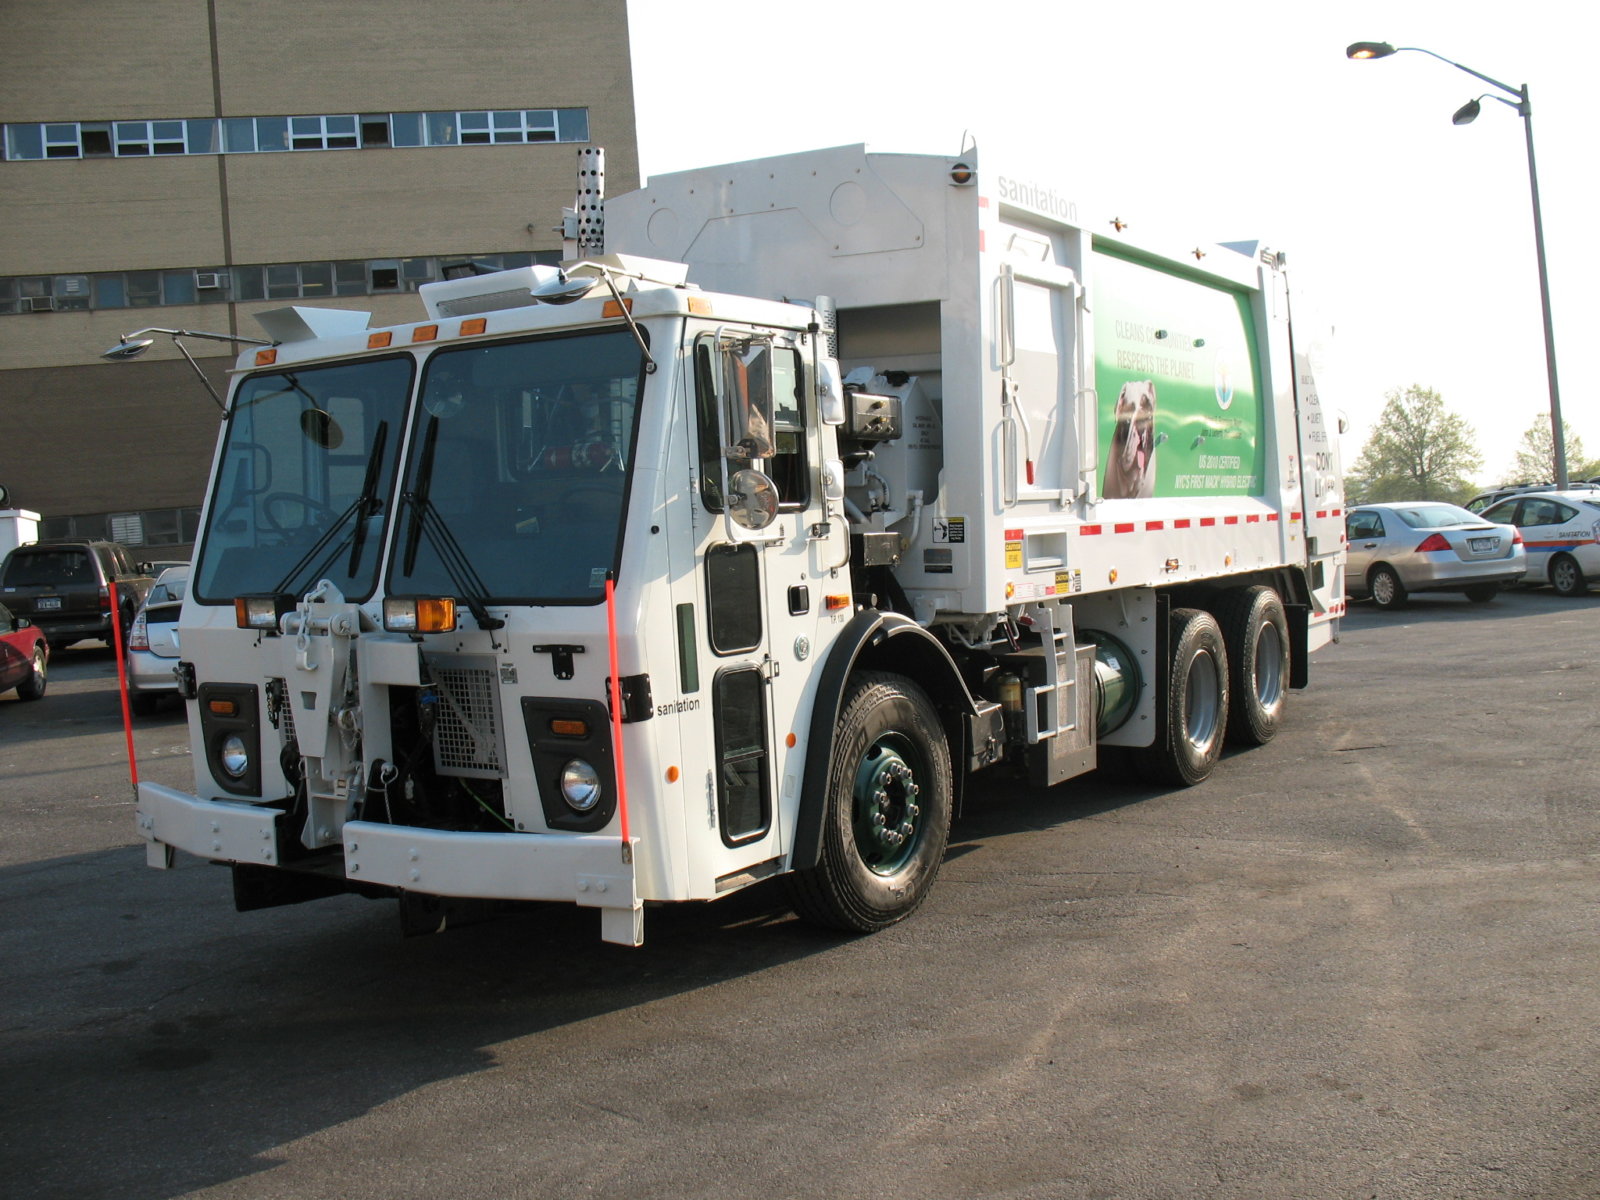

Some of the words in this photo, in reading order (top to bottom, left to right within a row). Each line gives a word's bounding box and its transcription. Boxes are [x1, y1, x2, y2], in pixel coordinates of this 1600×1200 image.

[998, 175, 1078, 222] sanitation
[1115, 319, 1145, 343] CLEANS
[1117, 349, 1154, 374] RESPECTS
[1156, 356, 1169, 375] THE
[1190, 475, 1205, 488] FIRST
[657, 698, 700, 716] sanitation
